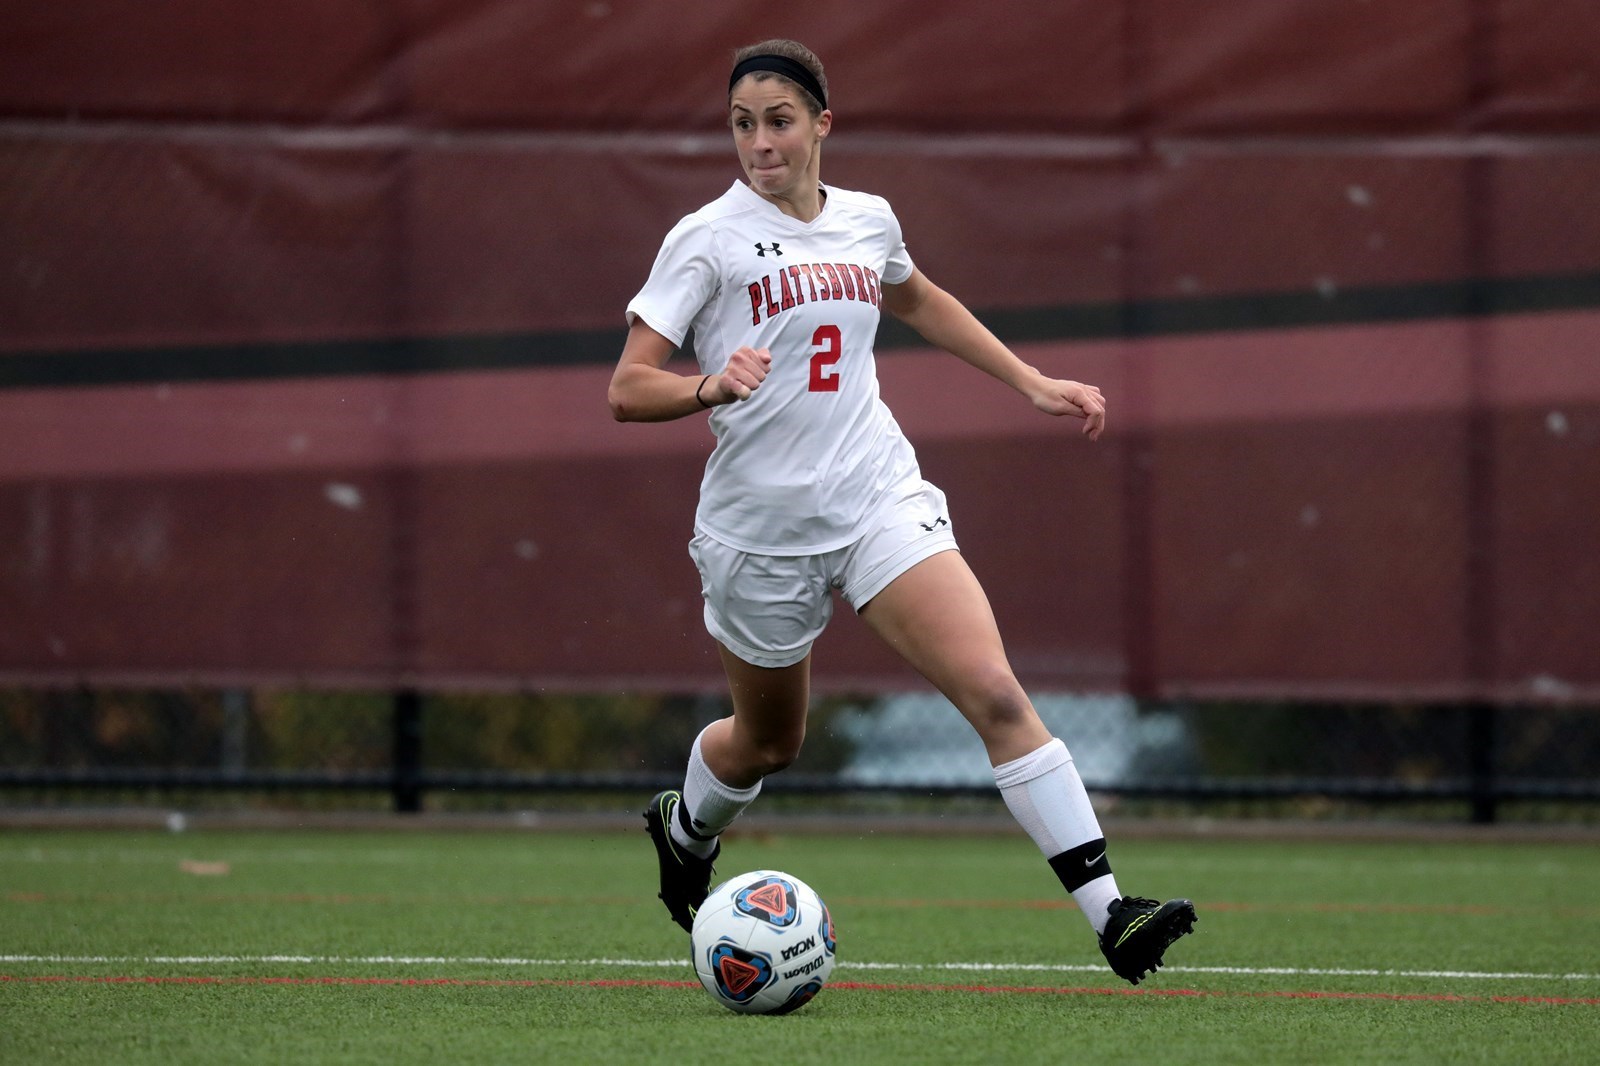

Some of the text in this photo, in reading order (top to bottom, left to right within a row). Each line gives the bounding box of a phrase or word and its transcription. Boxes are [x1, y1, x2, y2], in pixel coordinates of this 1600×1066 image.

[808, 325, 841, 392] 2
[781, 935, 815, 961] NCAA
[784, 955, 824, 979] Wilson
